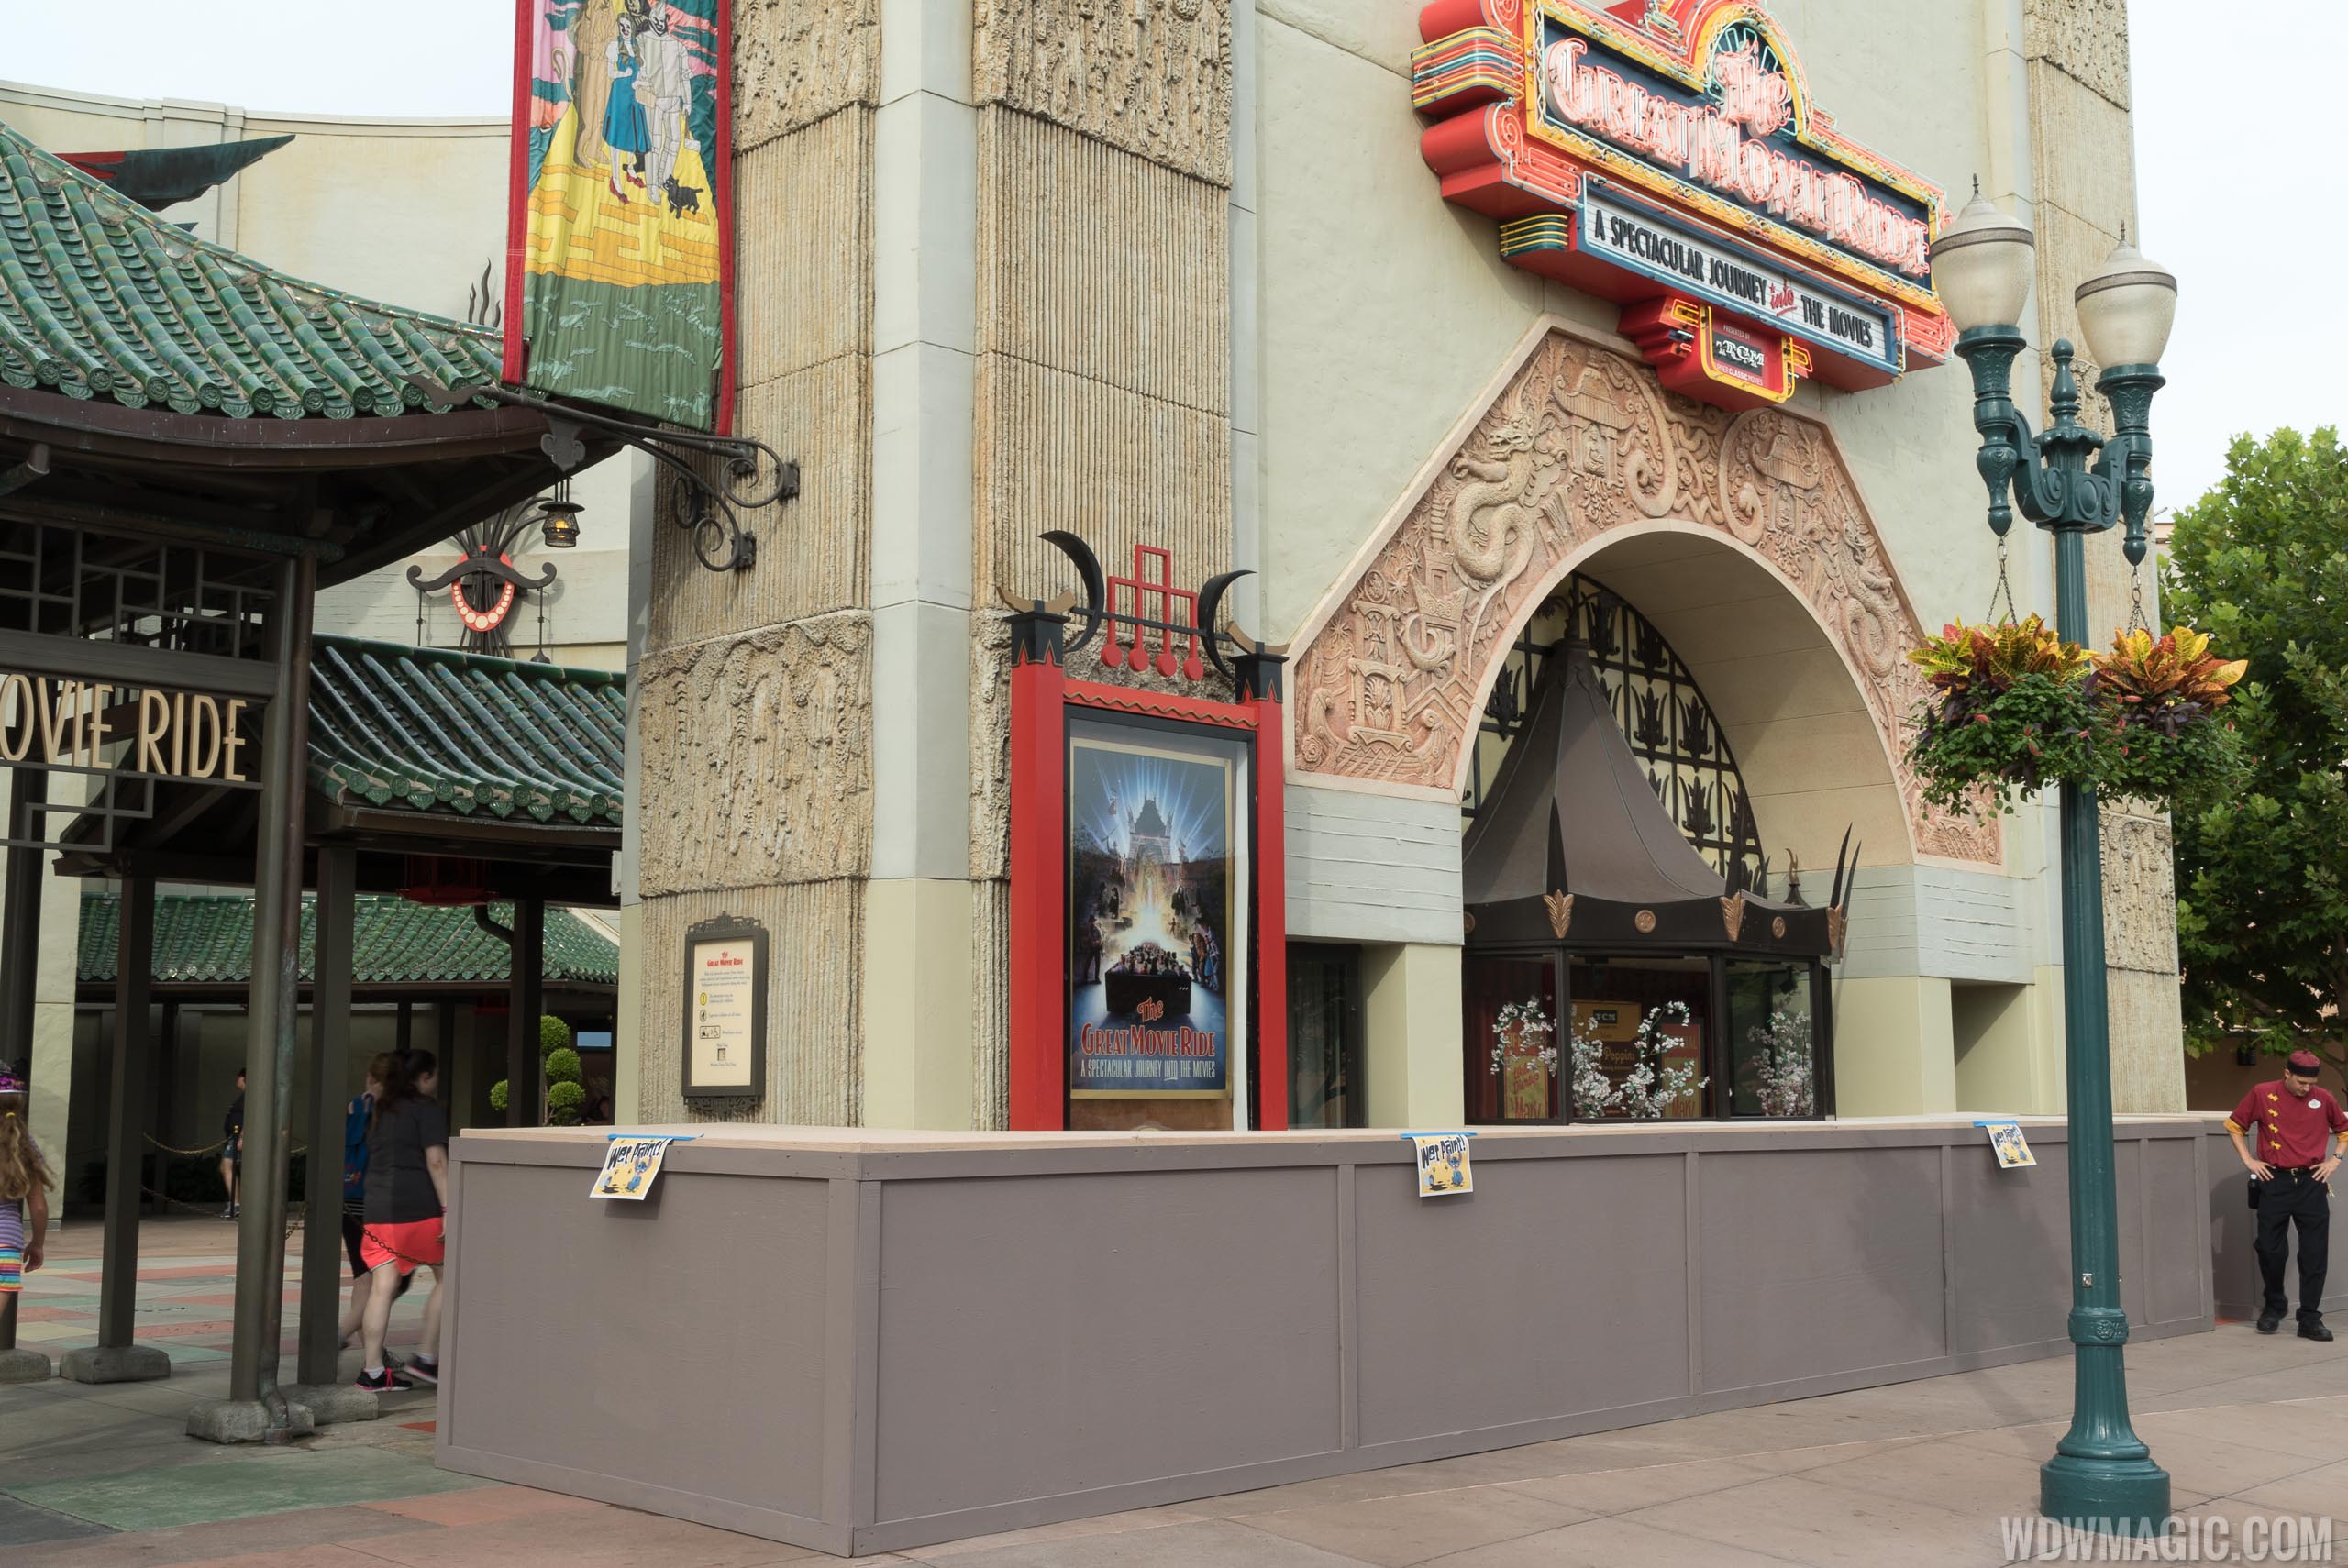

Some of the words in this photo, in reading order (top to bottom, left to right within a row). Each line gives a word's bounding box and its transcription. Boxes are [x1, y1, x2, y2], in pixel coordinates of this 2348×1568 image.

[1714, 39, 1790, 138] The
[1595, 209, 1606, 241] A
[1611, 215, 1705, 282] SPECTACULAR
[1709, 257, 1767, 306] JOURNEY
[1769, 278, 1795, 310] into
[1800, 294, 1825, 329] THE
[1829, 305, 1873, 348] MOVIES
[1716, 339, 1765, 368] TCM
[138, 689, 247, 782] RIDE
[1137, 996, 1164, 1022] The
[1595, 1012, 1616, 1021] TCM
[1081, 1022, 1129, 1055] GREAT
[1130, 1024, 1178, 1056] MOVIE
[1180, 1026, 1215, 1056] RIDE
[1080, 1060, 1086, 1077] A
[1088, 1059, 1132, 1077] SPECTACULAR
[1134, 1060, 1162, 1078] JOURNEY
[1164, 1060, 1179, 1079] INTO
[1180, 1060, 1191, 1078] THE
[1192, 1060, 1215, 1078] MOVIES
[1604, 1046, 1635, 1064] Poppins
